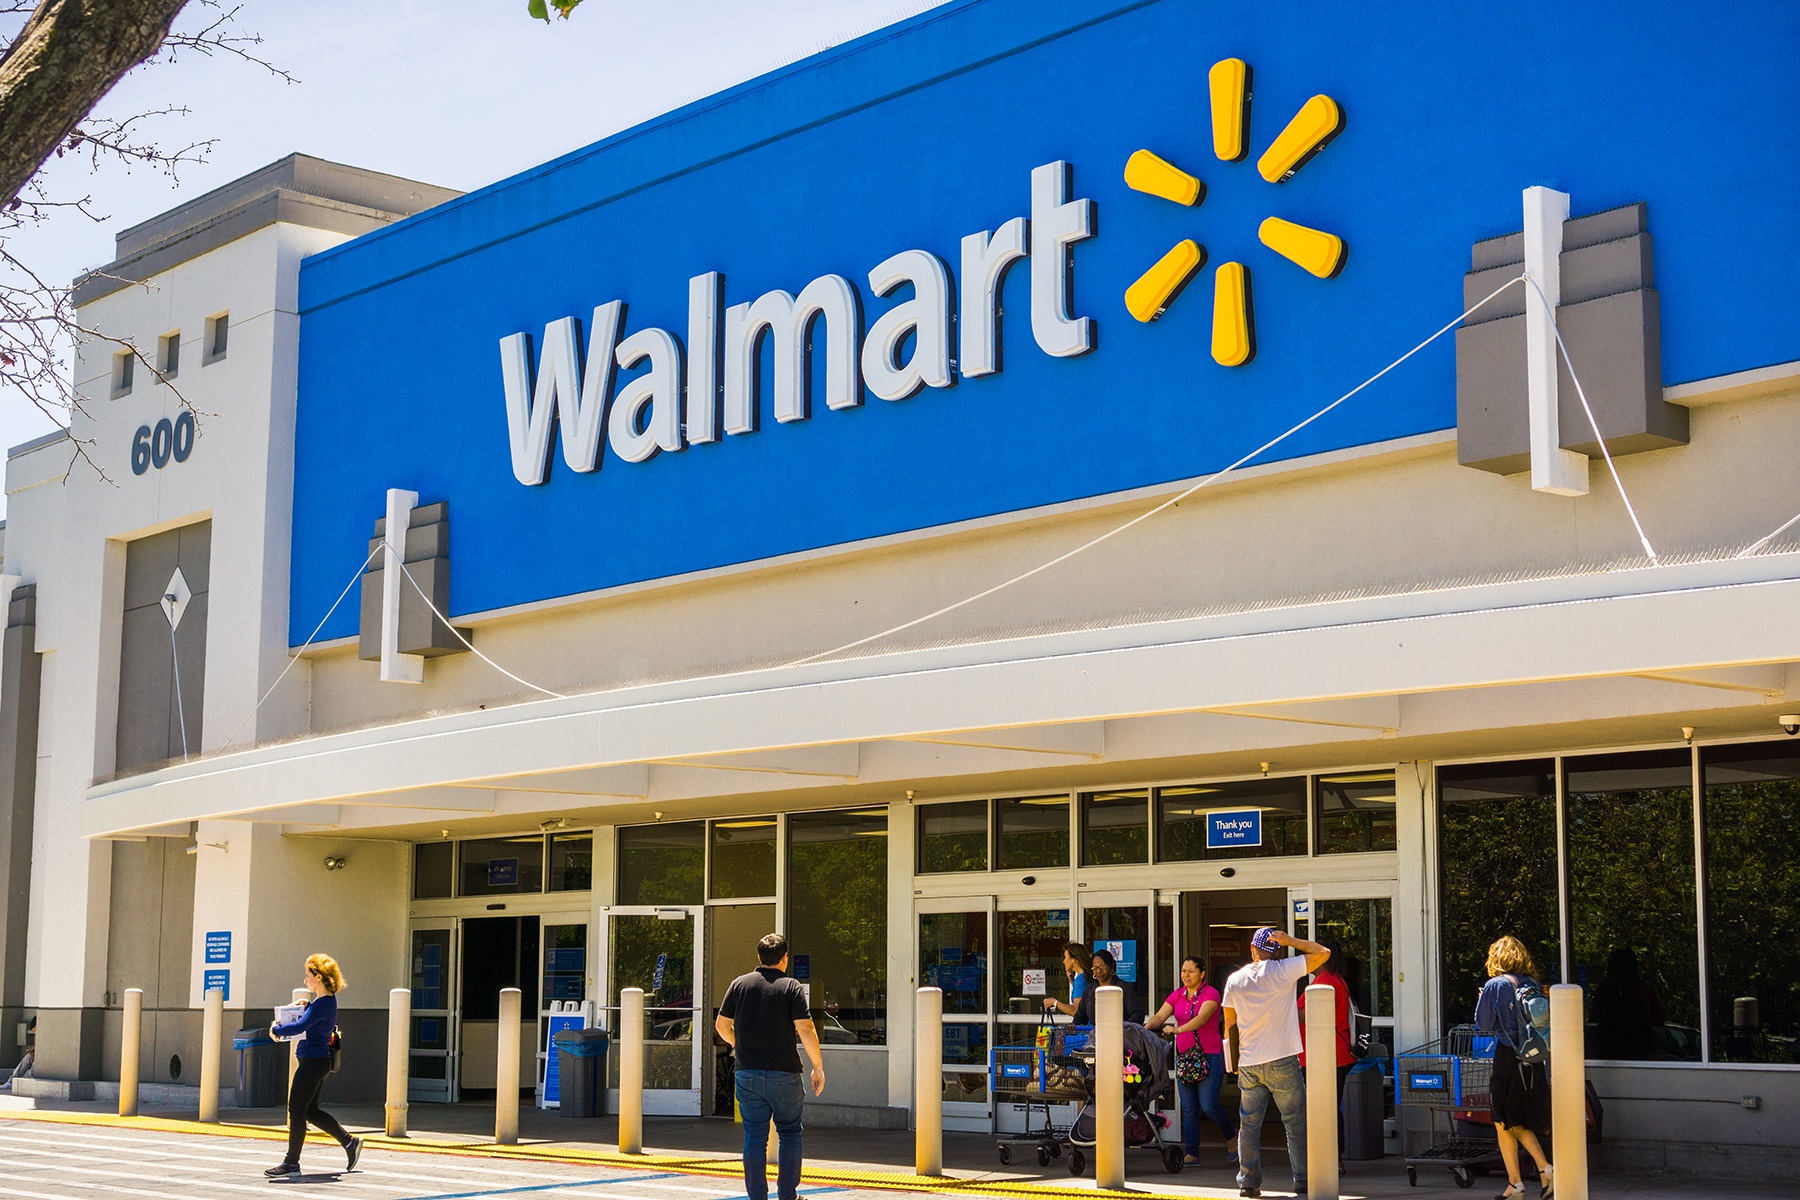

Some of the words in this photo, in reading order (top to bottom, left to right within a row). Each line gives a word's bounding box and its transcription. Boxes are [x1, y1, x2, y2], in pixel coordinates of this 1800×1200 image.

[499, 160, 1098, 486] Walmart
[131, 411, 195, 476] 600
[1215, 820, 1238, 830] Thank
[1238, 820, 1253, 831] you
[945, 1028, 961, 1038] EBT
